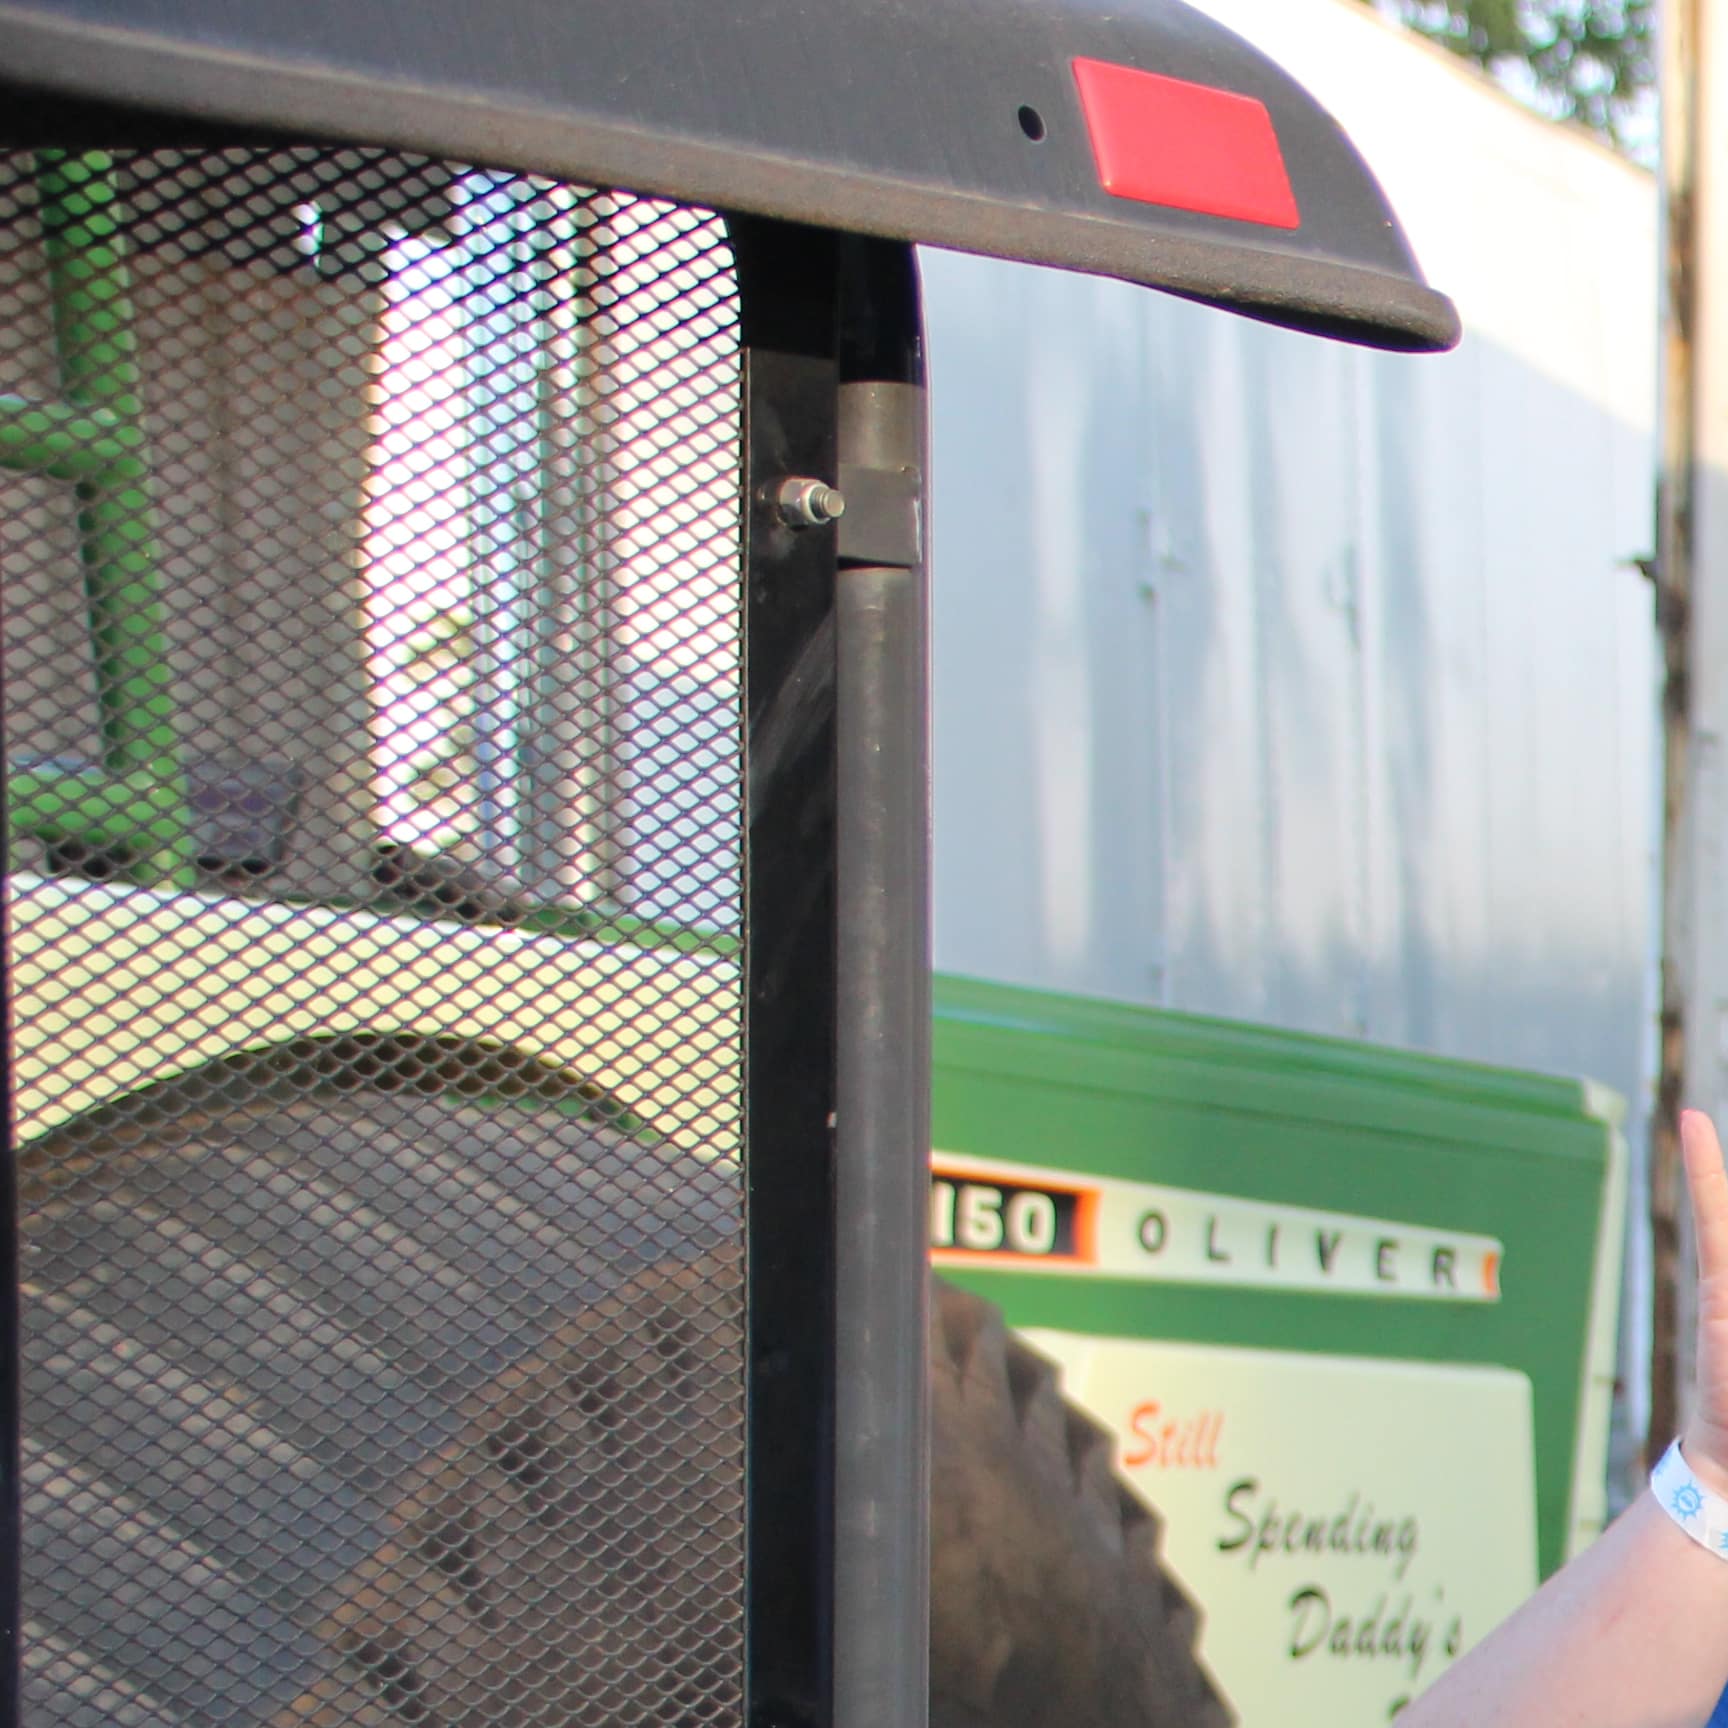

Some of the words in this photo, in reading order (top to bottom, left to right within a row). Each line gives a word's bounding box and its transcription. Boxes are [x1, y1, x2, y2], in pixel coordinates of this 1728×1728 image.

[1138, 1208, 1456, 1288] OLIVER
[1124, 1400, 1224, 1469] Still
[1217, 1477, 1419, 1581] Spending
[1289, 1585, 1462, 1680] Daddy's
